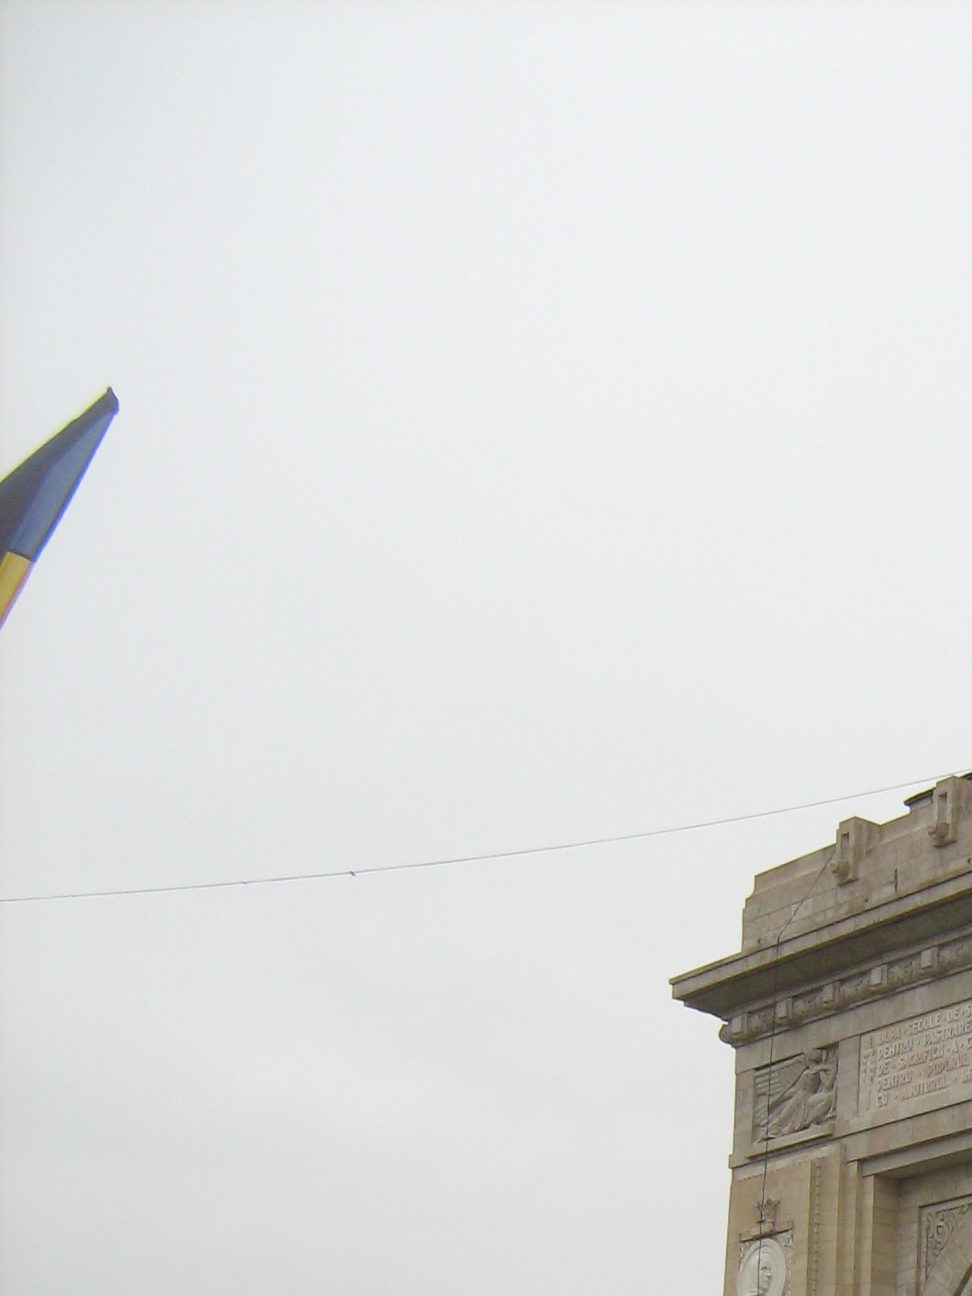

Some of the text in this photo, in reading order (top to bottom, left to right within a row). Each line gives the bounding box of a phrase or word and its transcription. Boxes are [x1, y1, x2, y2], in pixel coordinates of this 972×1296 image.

[947, 1007, 959, 1024] DE
[877, 1037, 913, 1061] PENTRU
[951, 1039, 958, 1054] A
[876, 1091, 888, 1108] CU
